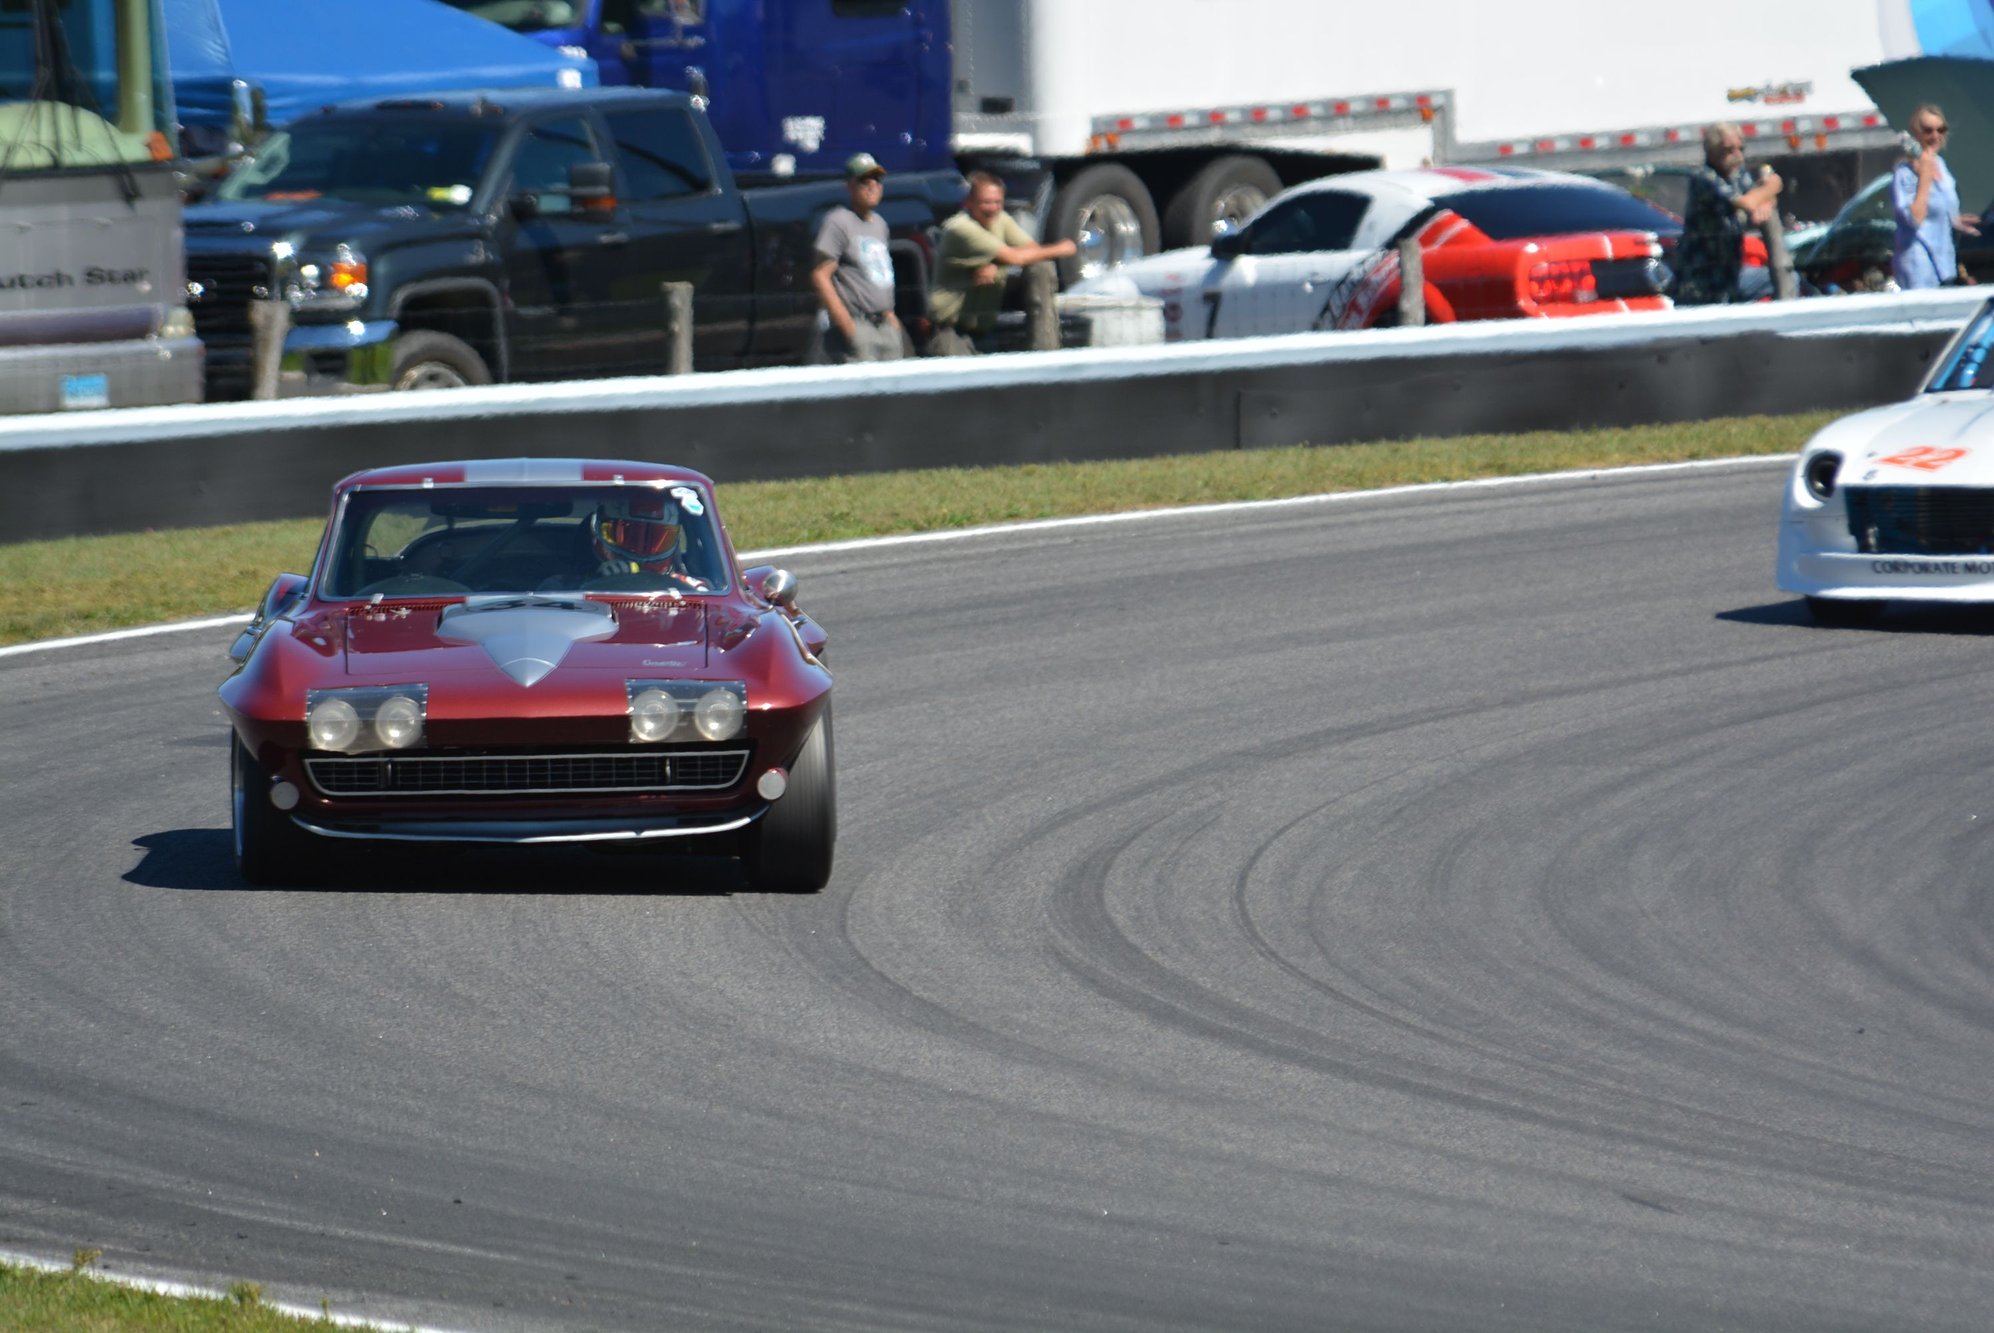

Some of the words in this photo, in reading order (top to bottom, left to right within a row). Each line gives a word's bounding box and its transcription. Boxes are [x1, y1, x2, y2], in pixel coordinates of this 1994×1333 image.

[85, 265, 149, 285] Star
[1876, 446, 1969, 472] 22
[1872, 560, 1959, 575] CORPORATE
